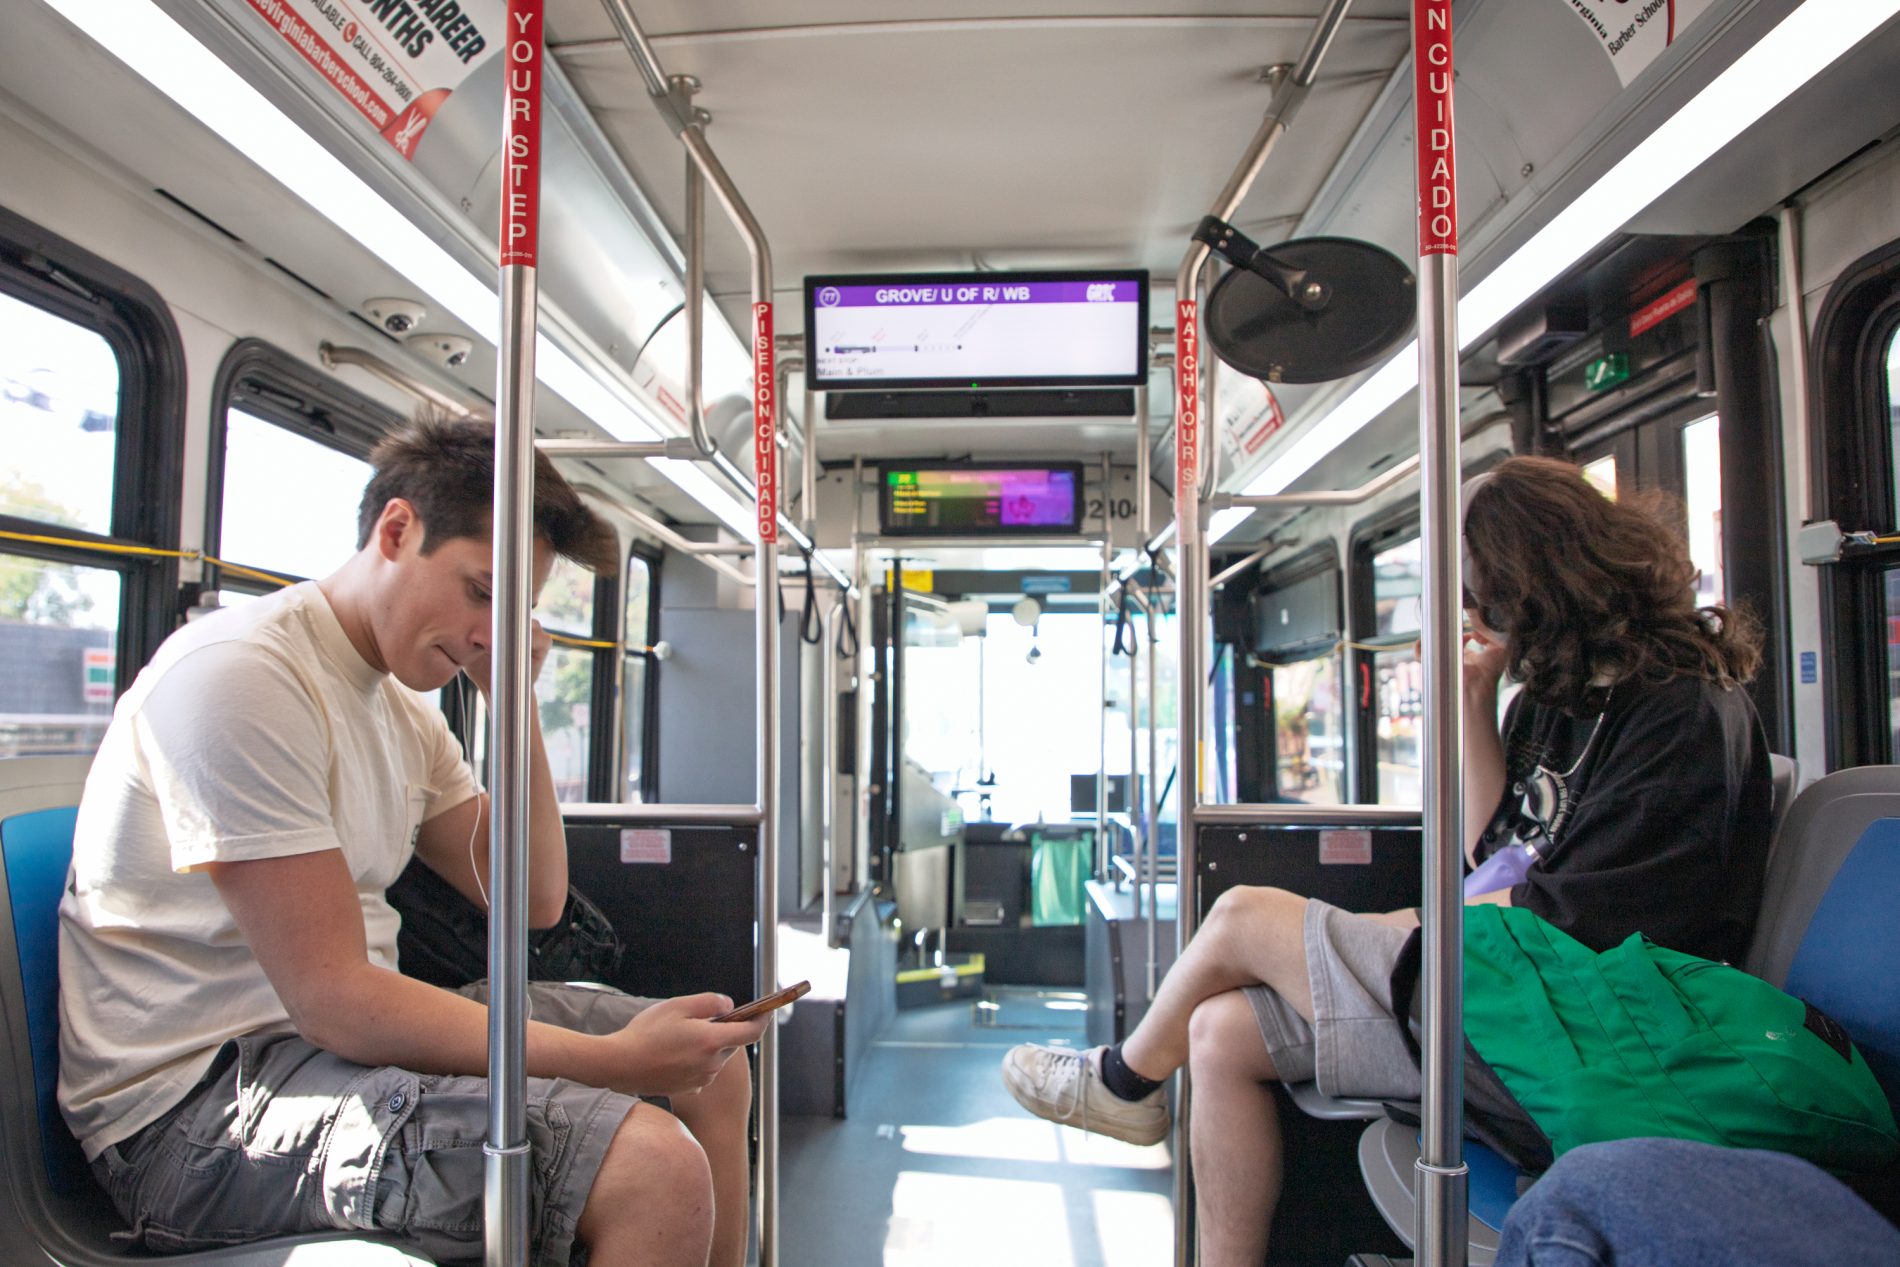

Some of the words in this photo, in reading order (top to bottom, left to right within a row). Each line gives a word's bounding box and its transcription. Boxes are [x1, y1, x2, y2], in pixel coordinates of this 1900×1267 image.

[352, 35, 370, 61] CALL
[359, 0, 434, 58] NTHS
[414, 0, 486, 65] AREER
[1608, 23, 1636, 56] Barber
[1635, 0, 1665, 28] Schoo
[512, 12, 534, 121] YOUR
[1428, 43, 1452, 238] CUIDADO
[508, 135, 528, 246] STEP
[875, 287, 937, 303] GROVE/
[941, 288, 952, 301] U
[956, 287, 979, 302] OF
[983, 286, 1000, 301] R/
[1002, 286, 1031, 301] WB
[757, 304, 769, 365] PISE
[1181, 304, 1196, 388] WATCH
[757, 371, 771, 418] CON
[1182, 394, 1195, 460] YOUR
[758, 424, 772, 535] CUIDADO
